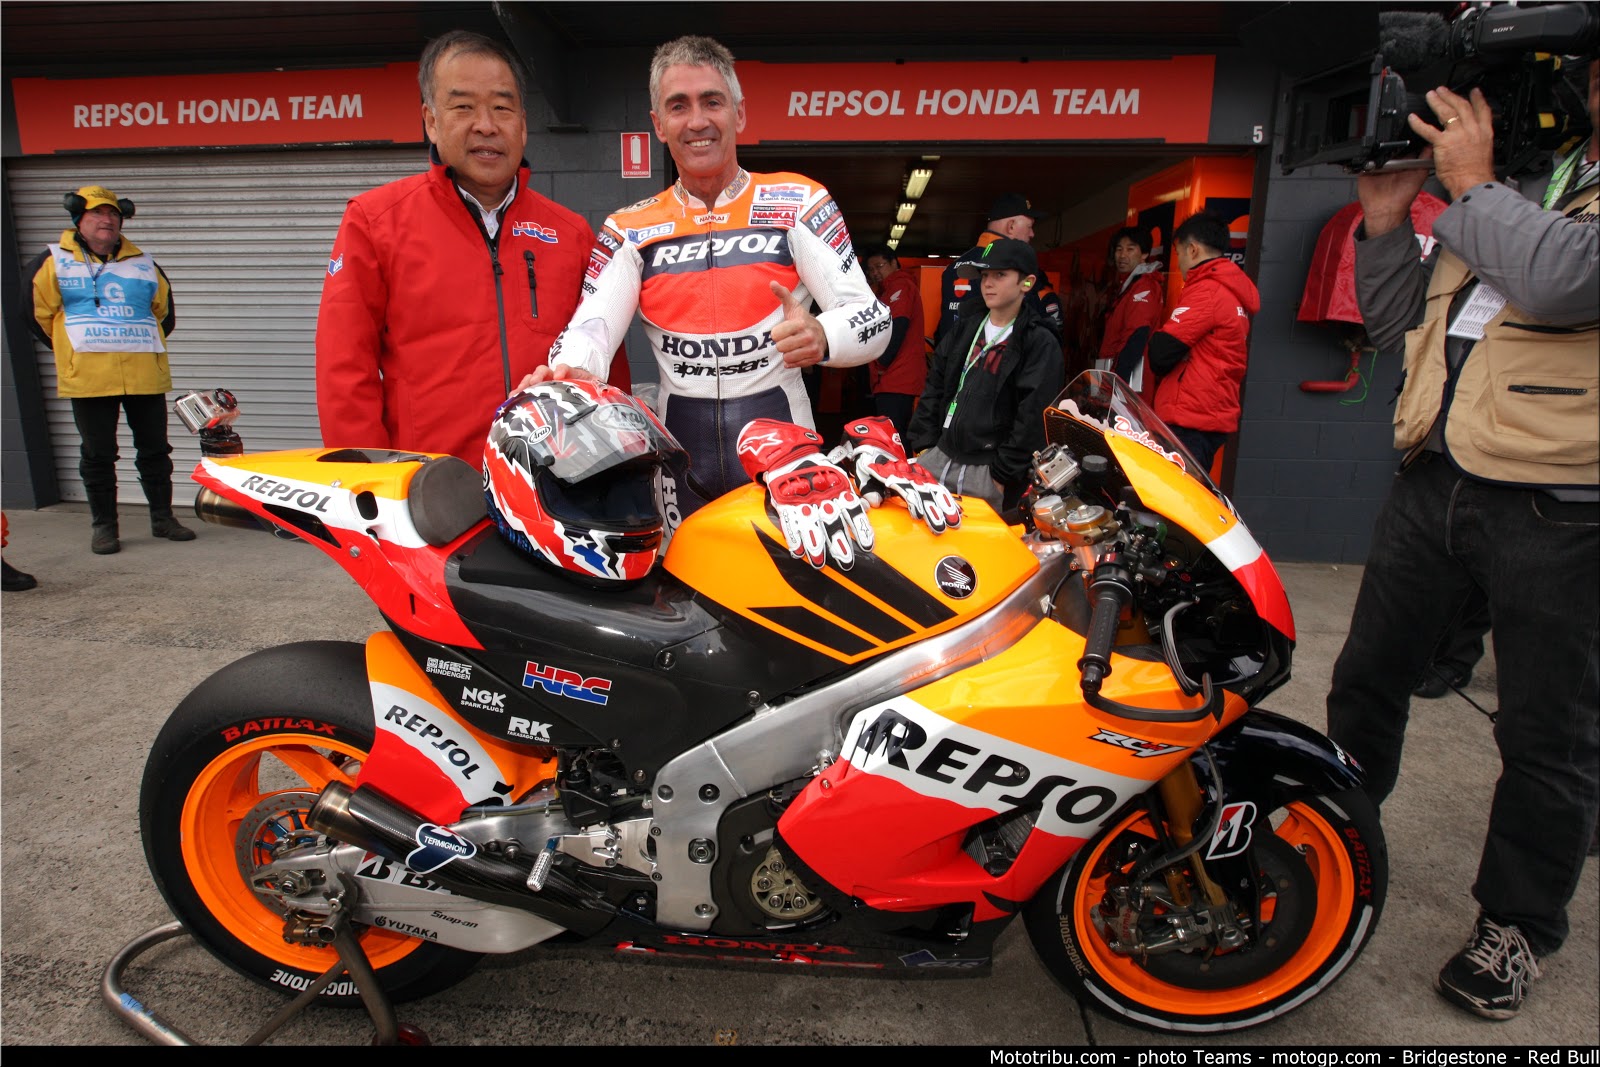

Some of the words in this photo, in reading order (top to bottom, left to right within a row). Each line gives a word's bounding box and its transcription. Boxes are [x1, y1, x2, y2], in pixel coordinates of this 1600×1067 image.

[1492, 25, 1515, 34] SONY
[73, 101, 169, 128] REPSOL
[177, 97, 281, 125] HONDA
[288, 93, 363, 121] TEAM
[787, 89, 905, 117] REPSOL
[915, 88, 1040, 116] HONDA
[1051, 88, 1140, 115] TEAM
[1252, 125, 1263, 144] 5
[760, 185, 805, 198] HRC
[699, 215, 725, 223] NANKAI
[752, 210, 795, 220] NANKAI
[512, 220, 559, 244] HRC
[636, 226, 671, 241] GAS
[651, 233, 783, 267] REPSOL
[58, 279, 79, 287] 2012
[103, 281, 126, 303] G
[96, 305, 135, 318] GRID
[84, 327, 152, 338] AUSTRALIA
[673, 355, 770, 379] alpinestars
[529, 426, 551, 442] Arai
[1114, 415, 1164, 454] Doohan
[240, 474, 332, 513] REPSOL
[425, 666, 472, 681] SHINDENGEN
[521, 660, 613, 706] HRC
[460, 699, 482, 710] SPARK
[482, 702, 505, 714] PLUGS
[461, 685, 507, 708] NGK
[220, 716, 338, 743] BATTLAX
[508, 715, 553, 739] RK
[383, 704, 481, 781] REPSOL
[857, 708, 1118, 824] REPSO
[424, 835, 468, 855] TERMIGNONI
[1344, 827, 1373, 897] BATTLAX
[388, 919, 438, 940] YUTAKA
[431, 910, 479, 929] Snap-on
[663, 935, 857, 955] HONDA
